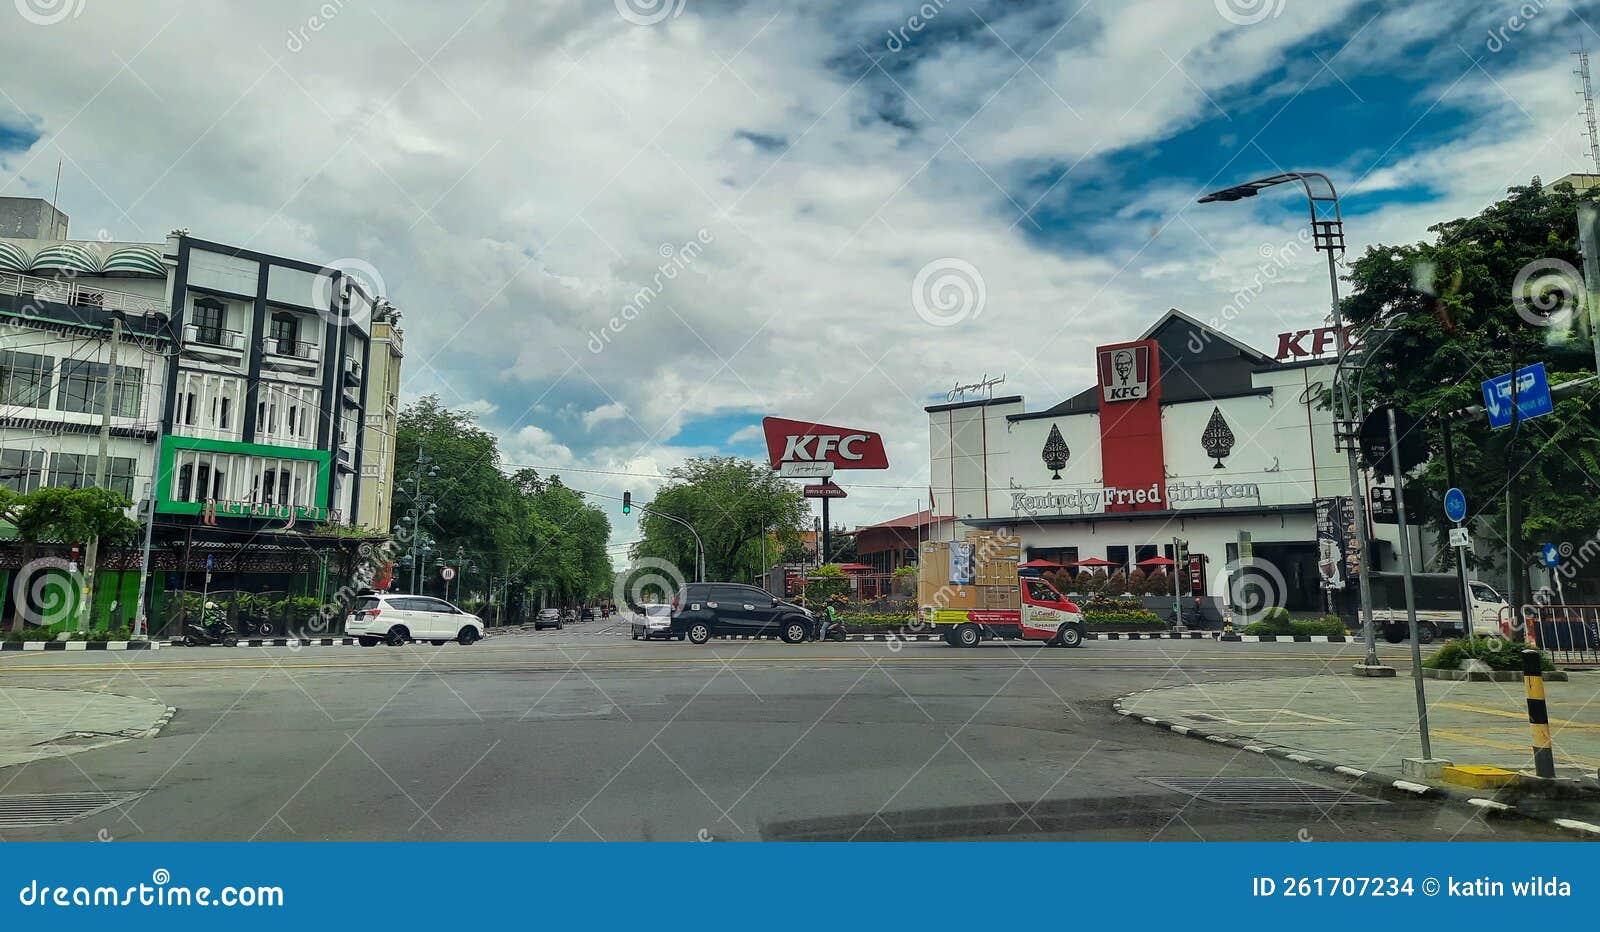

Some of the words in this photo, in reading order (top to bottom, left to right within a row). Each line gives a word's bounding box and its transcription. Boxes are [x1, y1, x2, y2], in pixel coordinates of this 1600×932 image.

[1275, 323, 1367, 359] KFC
[1110, 386, 1140, 399] KFC
[781, 434, 867, 460] KFC
[1011, 490, 1100, 515] Kentucky
[1103, 484, 1162, 505] Fried
[1166, 480, 1258, 501] Chicken
